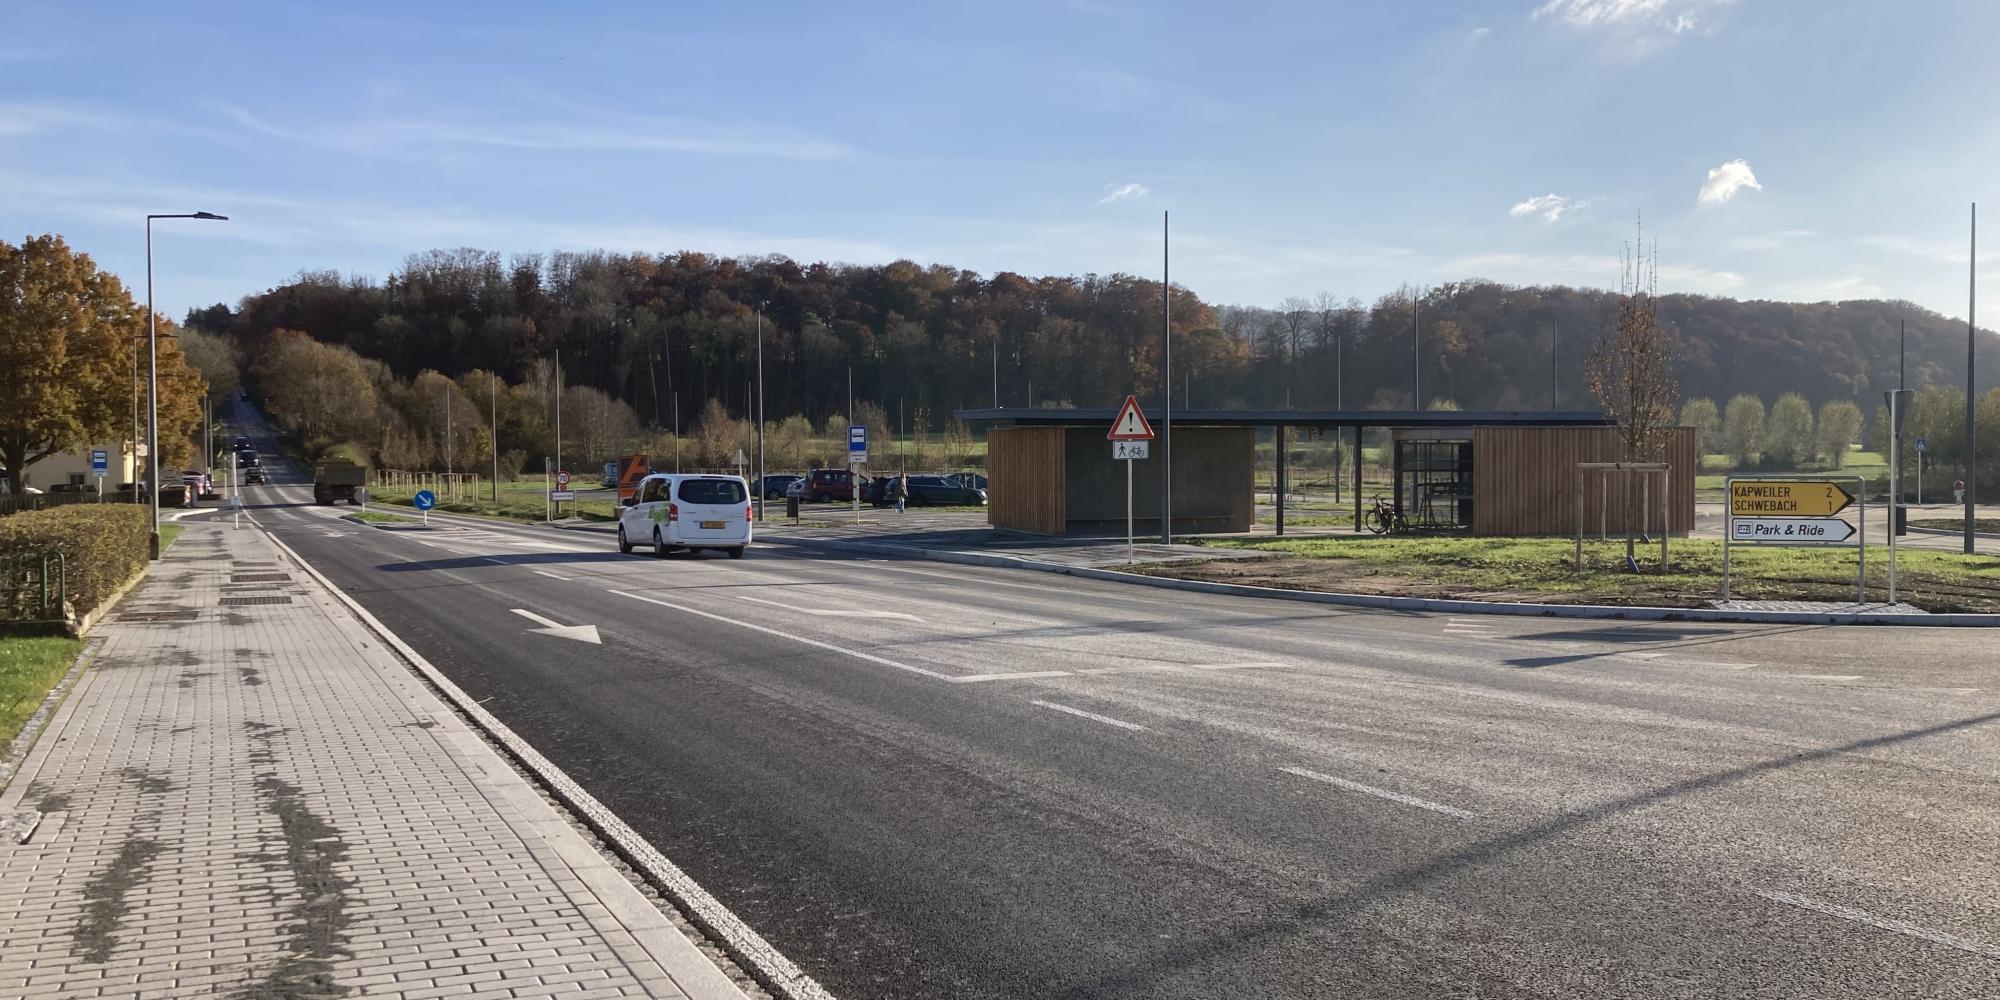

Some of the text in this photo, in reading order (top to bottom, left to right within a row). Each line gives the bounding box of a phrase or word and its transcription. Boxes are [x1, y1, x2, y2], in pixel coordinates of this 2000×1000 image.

[1734, 486, 1833, 498] KAPWEILER 2
[1734, 500, 1833, 512] SCHWEBACH 1
[1755, 524, 1825, 536] Park & Ride
